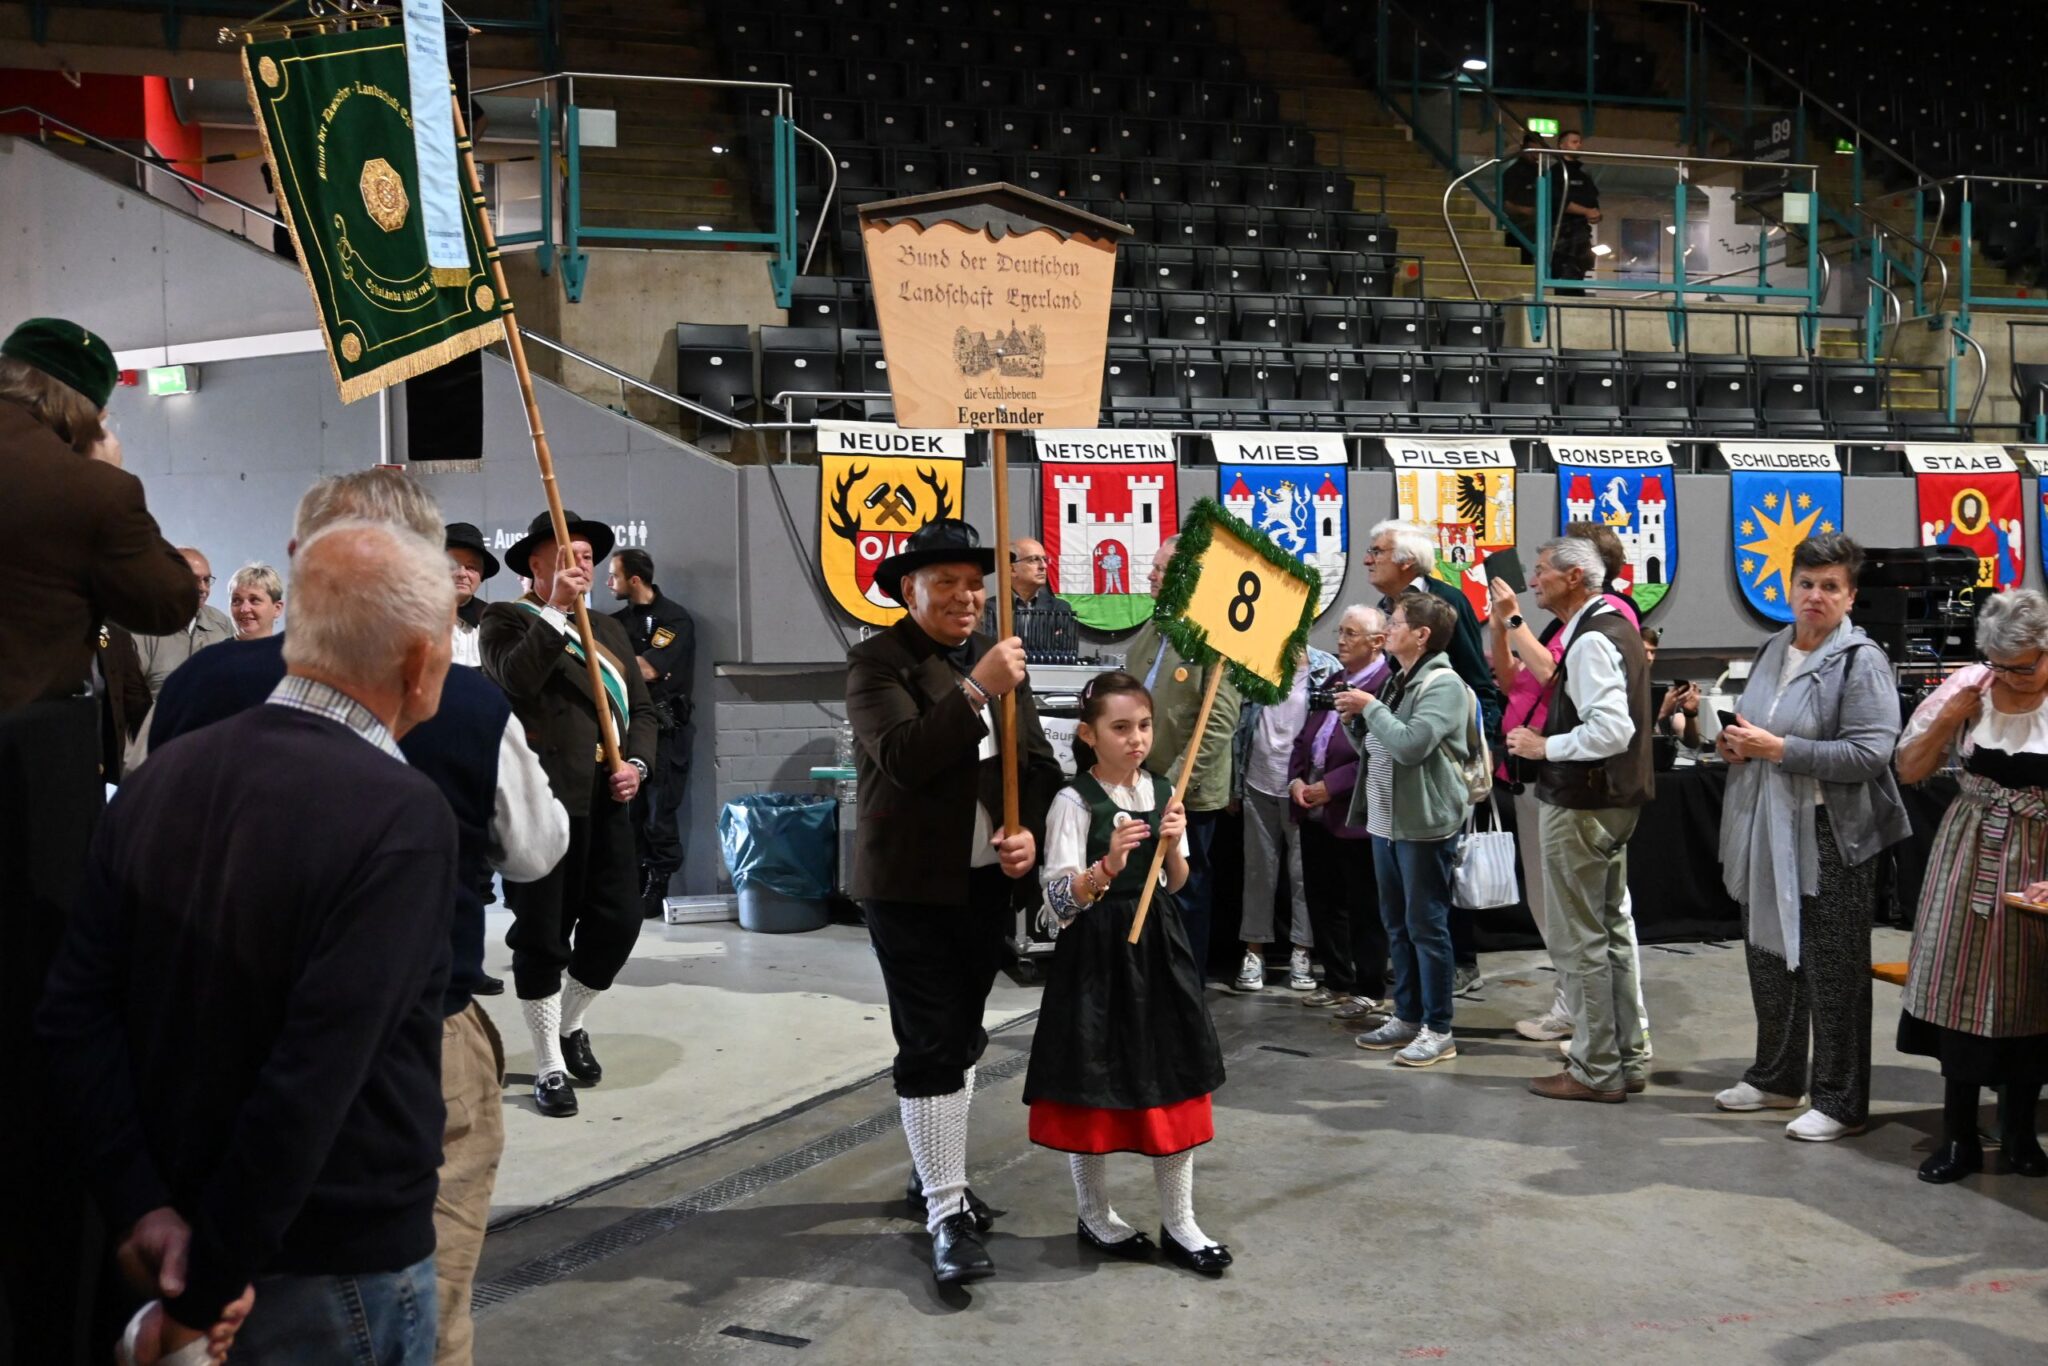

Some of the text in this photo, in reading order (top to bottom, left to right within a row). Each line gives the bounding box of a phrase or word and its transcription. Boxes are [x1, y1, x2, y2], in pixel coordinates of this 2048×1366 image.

[1772, 118, 1791, 144] B9
[896, 244, 950, 269] Bund
[960, 249, 986, 271] der
[964, 385, 1037, 400] die Verbliebenen
[840, 432, 944, 453] NEUDEK
[1045, 443, 1167, 459] NETSCHETIN
[1239, 444, 1319, 461] MIES
[1401, 449, 1501, 465] PILSEN
[1558, 448, 1664, 464] RONSPERG
[1731, 453, 1831, 468] SCHILDBERG
[1923, 456, 2002, 470] STAAB
[1228, 570, 1261, 632] 8
